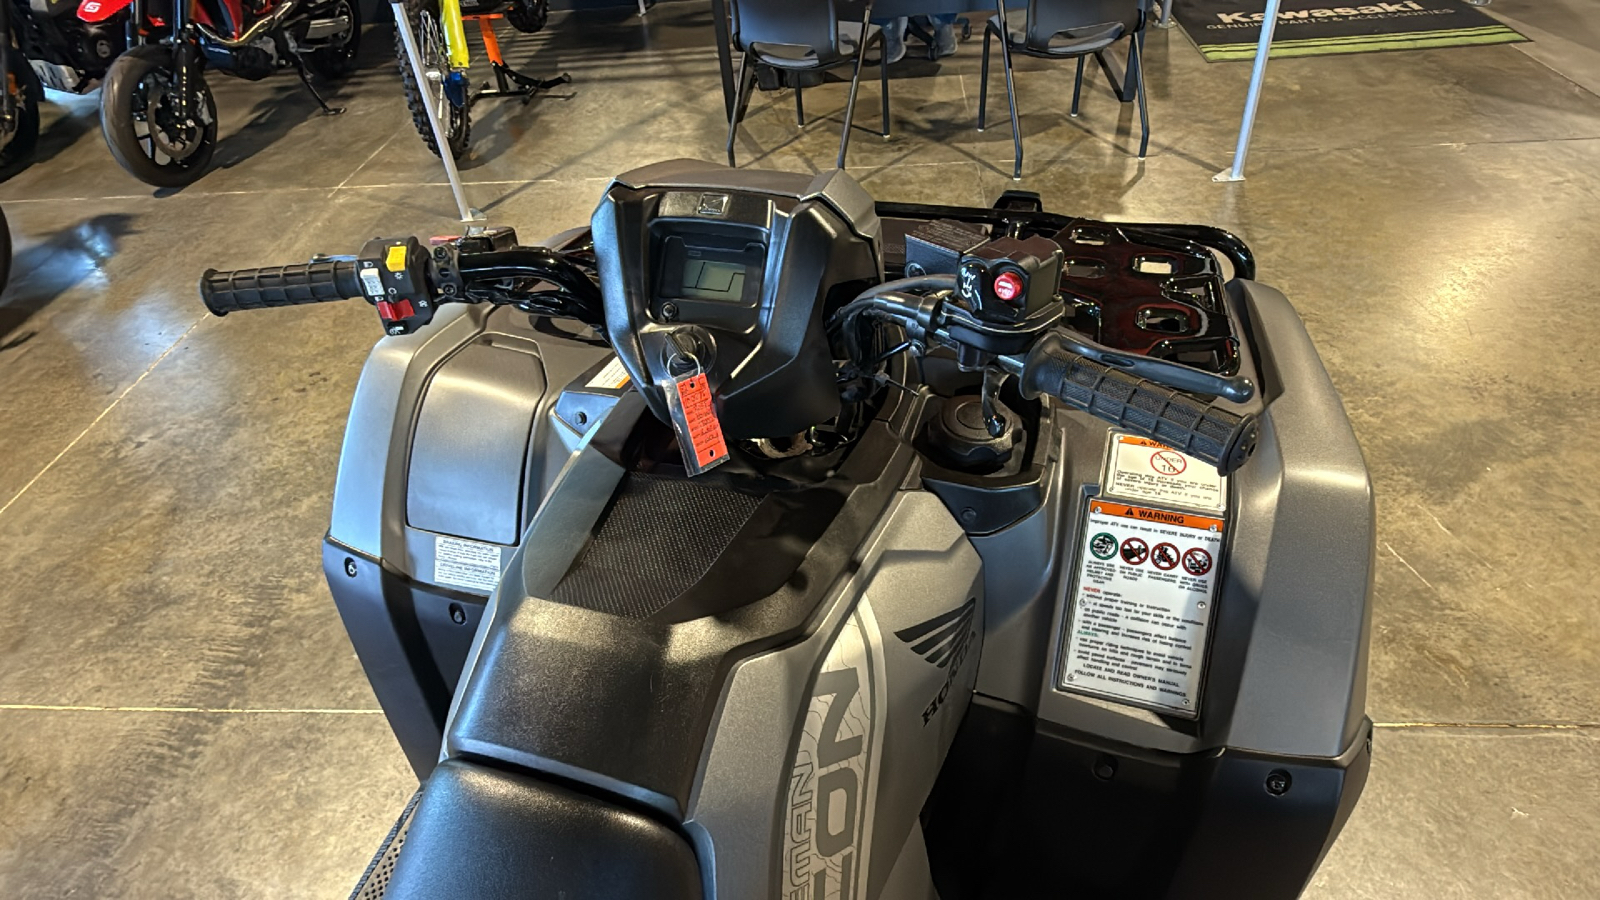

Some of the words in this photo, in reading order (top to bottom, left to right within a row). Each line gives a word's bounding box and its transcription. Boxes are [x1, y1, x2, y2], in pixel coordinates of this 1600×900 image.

[1206, 21, 1264, 30] GENUIN
[1279, 17, 1328, 27] PARTS
[1347, 8, 1456, 23] ACCESSORIES
[1217, 1, 1426, 25] Kawasaki
[1154, 455, 1182, 464] UNDER
[1138, 509, 1184, 524] WARNING
[1120, 599, 1137, 607] training
[1097, 623, 1120, 631] passenger
[1126, 628, 1152, 637] passengers
[1119, 645, 1144, 653] techniques
[921, 630, 977, 728] HONDA
[1082, 663, 1102, 671] LOCATE
[1116, 669, 1130, 677] READ
[1132, 673, 1155, 682] OWNER'S
[1074, 669, 1095, 677] FOLLOW
[1107, 676, 1144, 688] INSTRUCTIONS
[1158, 686, 1186, 697] WARNINGS
